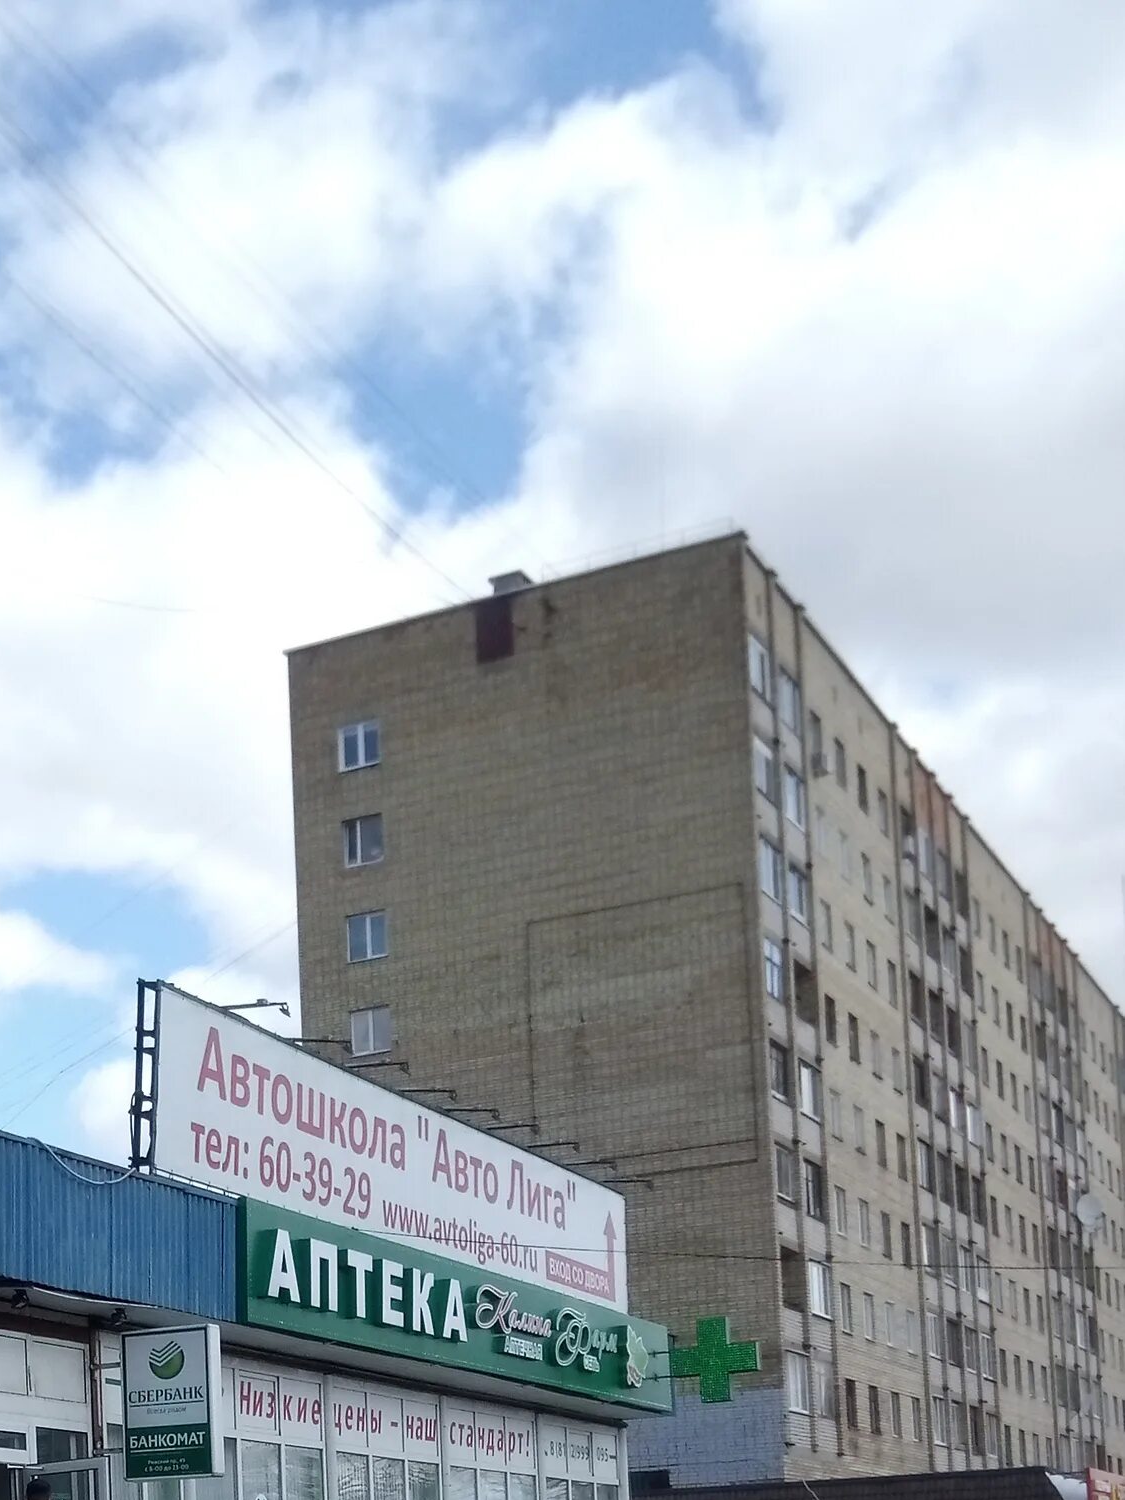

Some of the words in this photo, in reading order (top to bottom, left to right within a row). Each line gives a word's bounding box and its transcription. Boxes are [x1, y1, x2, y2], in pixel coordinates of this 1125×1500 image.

[196, 1026, 406, 1171] Автошкола
[506, 1159, 576, 1231] Лига"
[190, 1121, 249, 1180] тел:
[258, 1135, 372, 1220] 60-39-29
[382, 1199, 539, 1273] www.avtoliga-60.ru
[267, 1228, 468, 1343] АПТЕКА
[549, 1257, 571, 1284] ВХОД
[571, 1263, 585, 1285] СО
[584, 1269, 611, 1294] ДВОРА
[128, 1385, 204, 1404] СБЕРБАНК
[239, 1380, 322, 1426] Низкие
[333, 1402, 382, 1437] цены
[406, 1415, 438, 1442] наш
[449, 1421, 530, 1462] стандарт!
[129, 1431, 206, 1449] БАНКОМАТ
